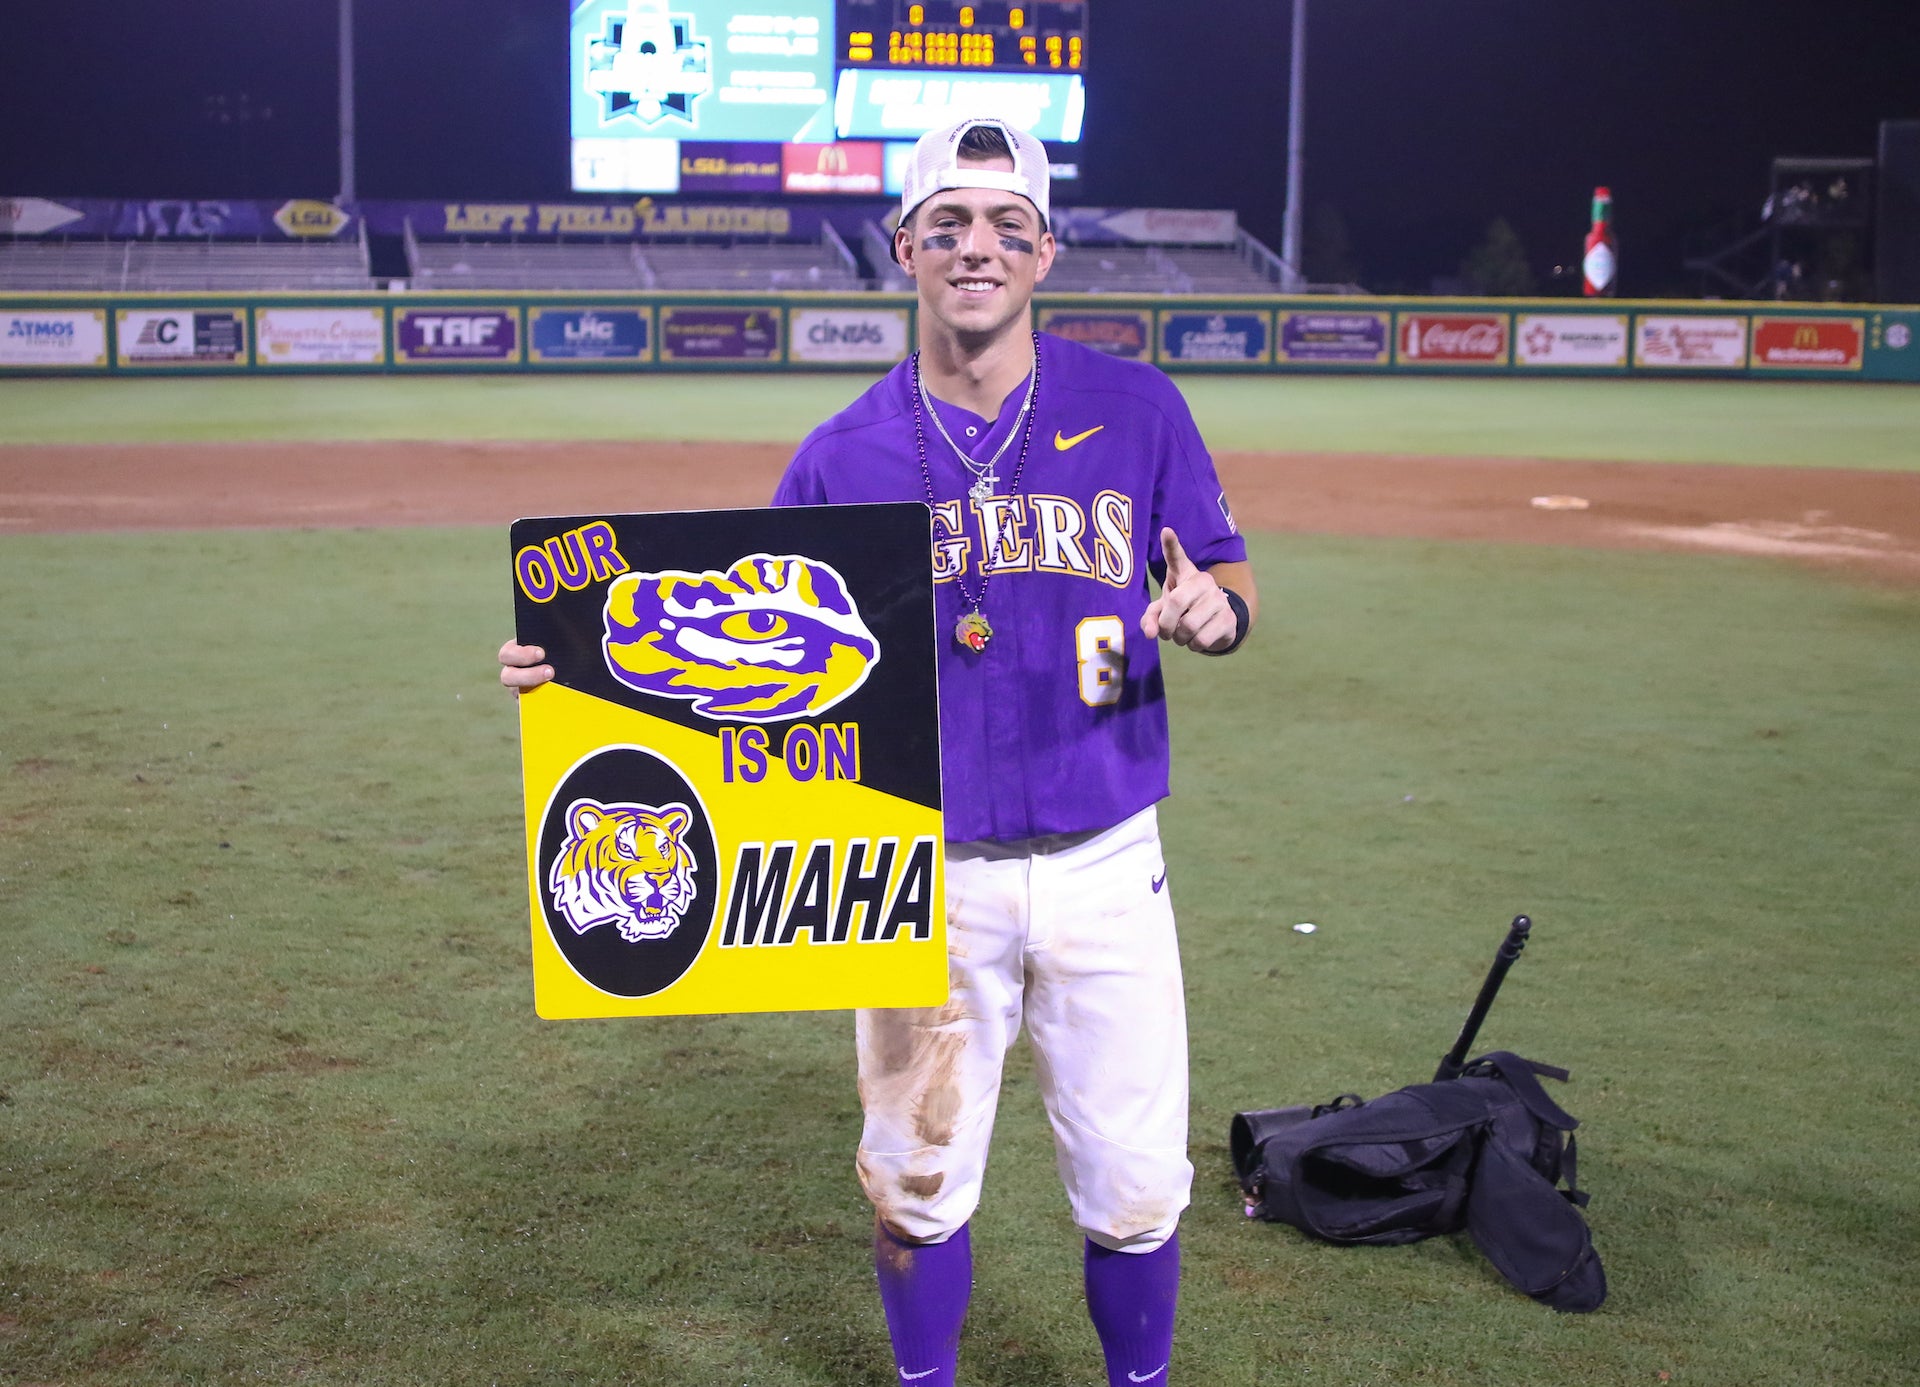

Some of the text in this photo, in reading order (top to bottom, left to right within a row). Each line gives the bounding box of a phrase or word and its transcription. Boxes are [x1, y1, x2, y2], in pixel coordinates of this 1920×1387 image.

[289, 211, 333, 226] LSU
[444, 204, 790, 234] LEFT FIELD LANDING
[413, 316, 500, 345] TAF
[515, 520, 630, 603] OUR
[1074, 614, 1125, 707] 8
[718, 722, 861, 784] IS ON
[718, 836, 937, 949] MAHA
